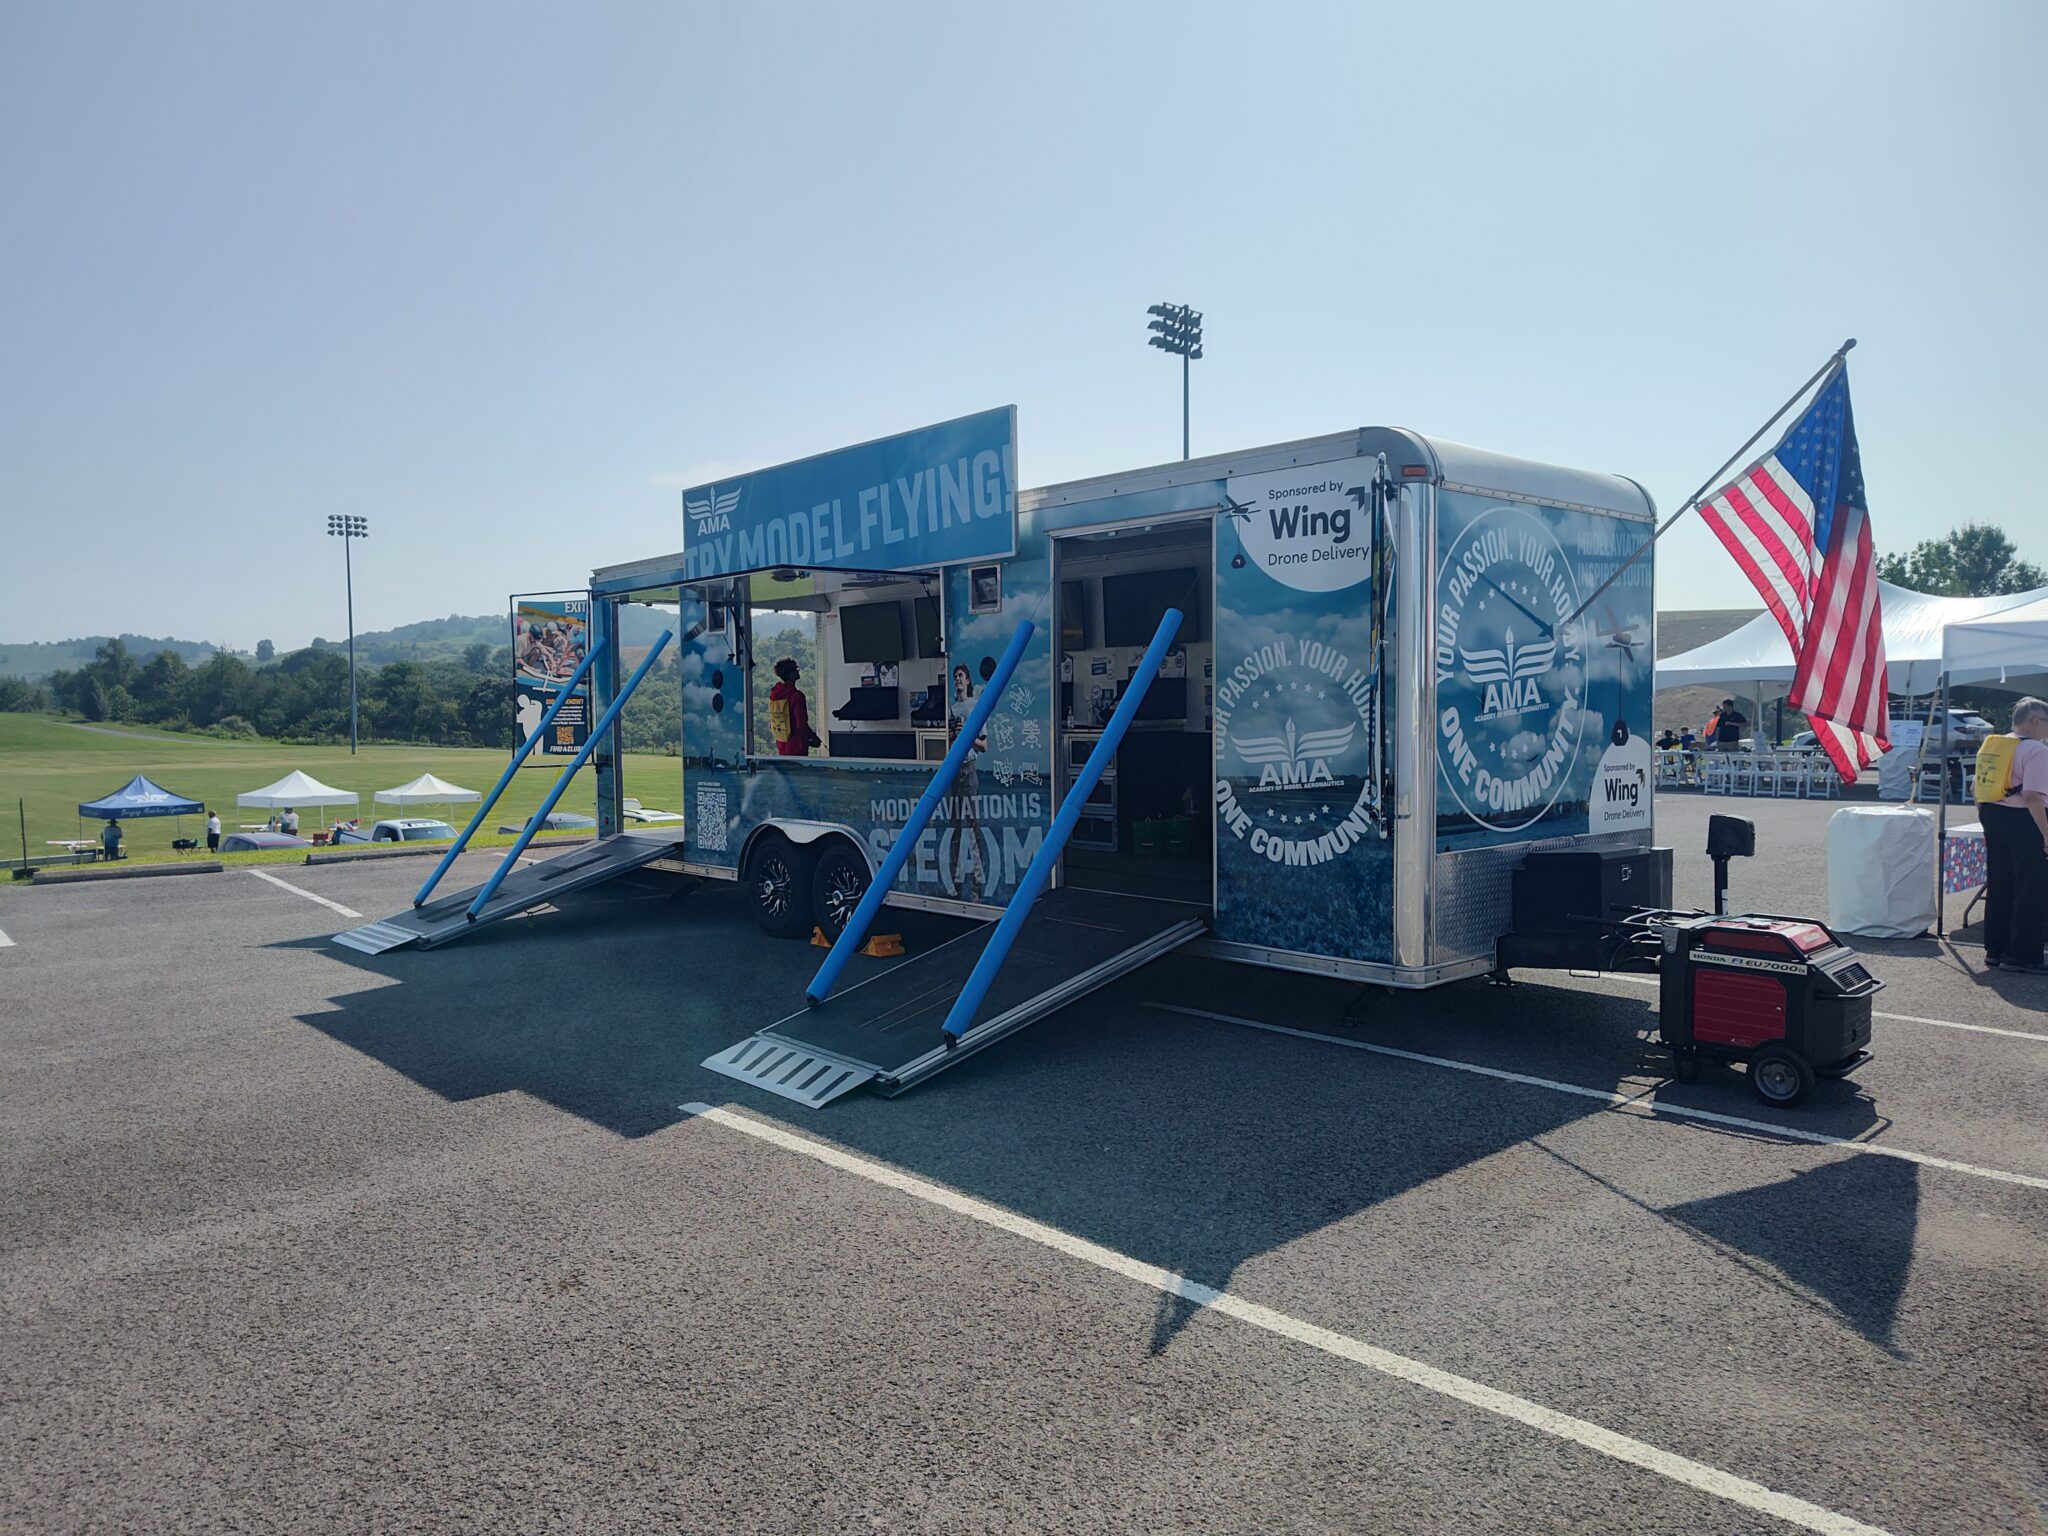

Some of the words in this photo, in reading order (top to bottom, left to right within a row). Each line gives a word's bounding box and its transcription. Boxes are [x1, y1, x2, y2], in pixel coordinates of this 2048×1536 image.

[1268, 481, 1326, 501] Sponsored
[1329, 480, 1344, 492] by
[738, 499, 855, 571] MODEL
[858, 444, 1013, 551] FLYING!
[698, 514, 731, 536] AMA
[1269, 505, 1351, 544] Wing
[1268, 553, 1308, 566] Drone
[1312, 546, 1370, 561] Delivery
[564, 601, 587, 613] EXIT
[1437, 604, 1460, 685] YOUR
[1449, 527, 1514, 608] PASSION.
[1519, 529, 1555, 587] YOUR
[1218, 641, 1292, 708] PASSION.
[1299, 639, 1348, 682] YOUR
[1484, 678, 1542, 713] AMA
[1441, 706, 1477, 786] ONE
[1475, 685, 1579, 812] COMMUNITY
[1259, 759, 1333, 787] AMA
[1604, 763, 1628, 773] Sponsored
[1629, 763, 1635, 771] by
[1303, 780, 1345, 789] AERONAUTICS
[1604, 778, 1638, 807] Wing
[931, 794, 1016, 821] AVIATION
[1023, 793, 1042, 818] IS
[1216, 779, 1254, 840] ONE
[1604, 811, 1621, 821] Drone
[1622, 808, 1646, 819] Delivery
[1693, 953, 1726, 963] HONDA
[1745, 960, 1806, 974] EU7000is
